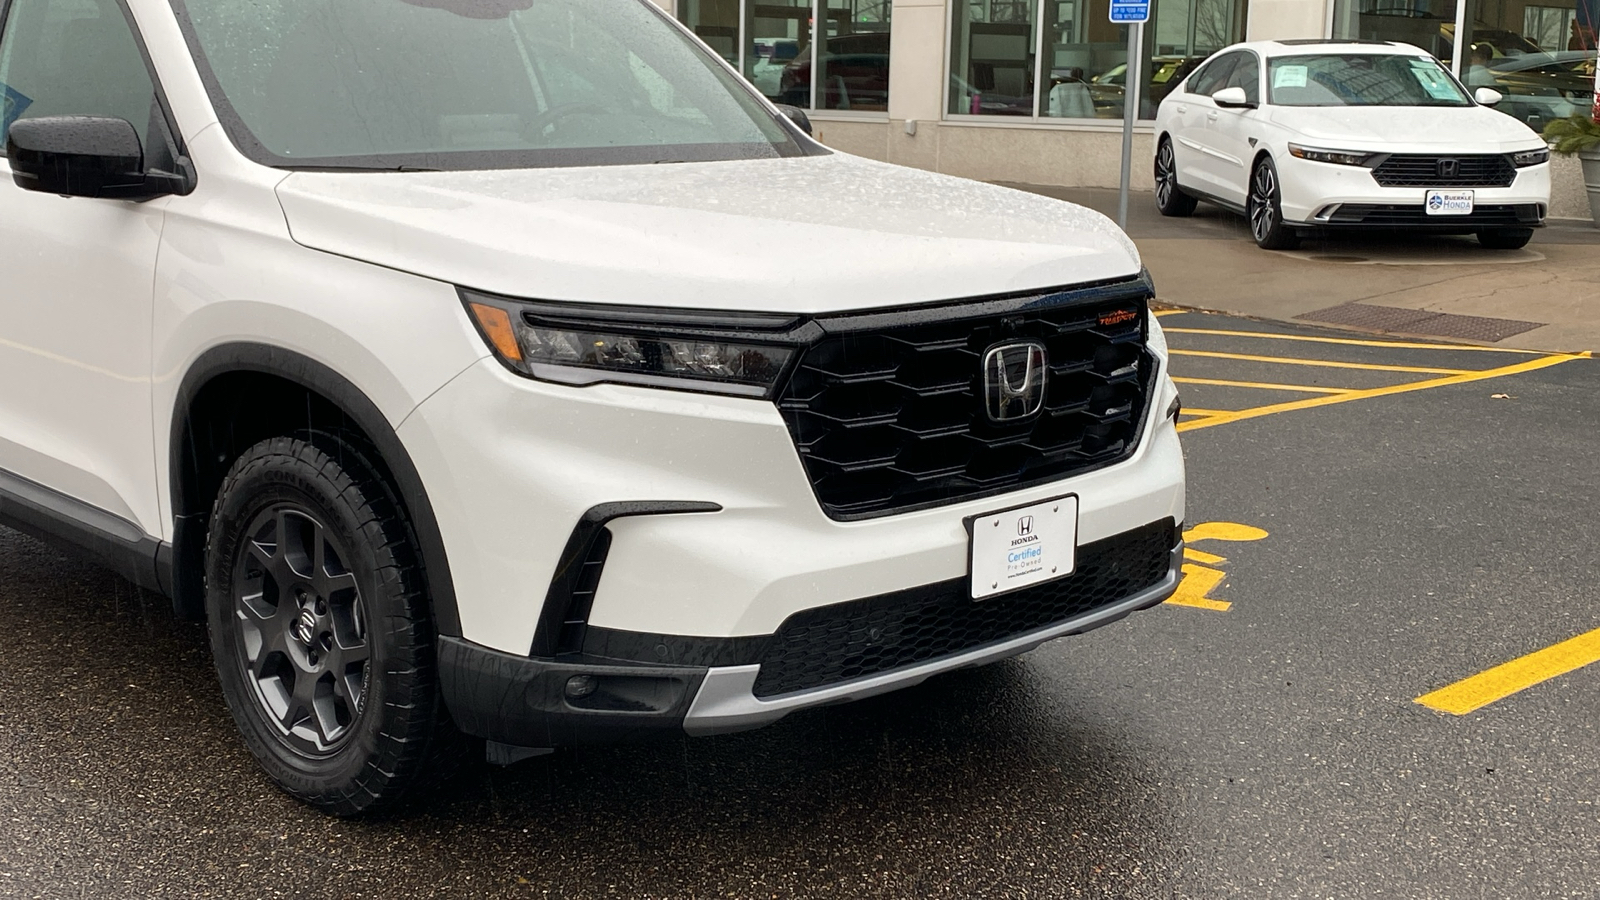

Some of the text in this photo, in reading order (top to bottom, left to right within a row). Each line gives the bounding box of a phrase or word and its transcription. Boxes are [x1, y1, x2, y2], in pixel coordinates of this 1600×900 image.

[1443, 200, 1471, 209] HONDA
[1011, 535, 1038, 546] HONDA
[1008, 545, 1041, 562] Certified
